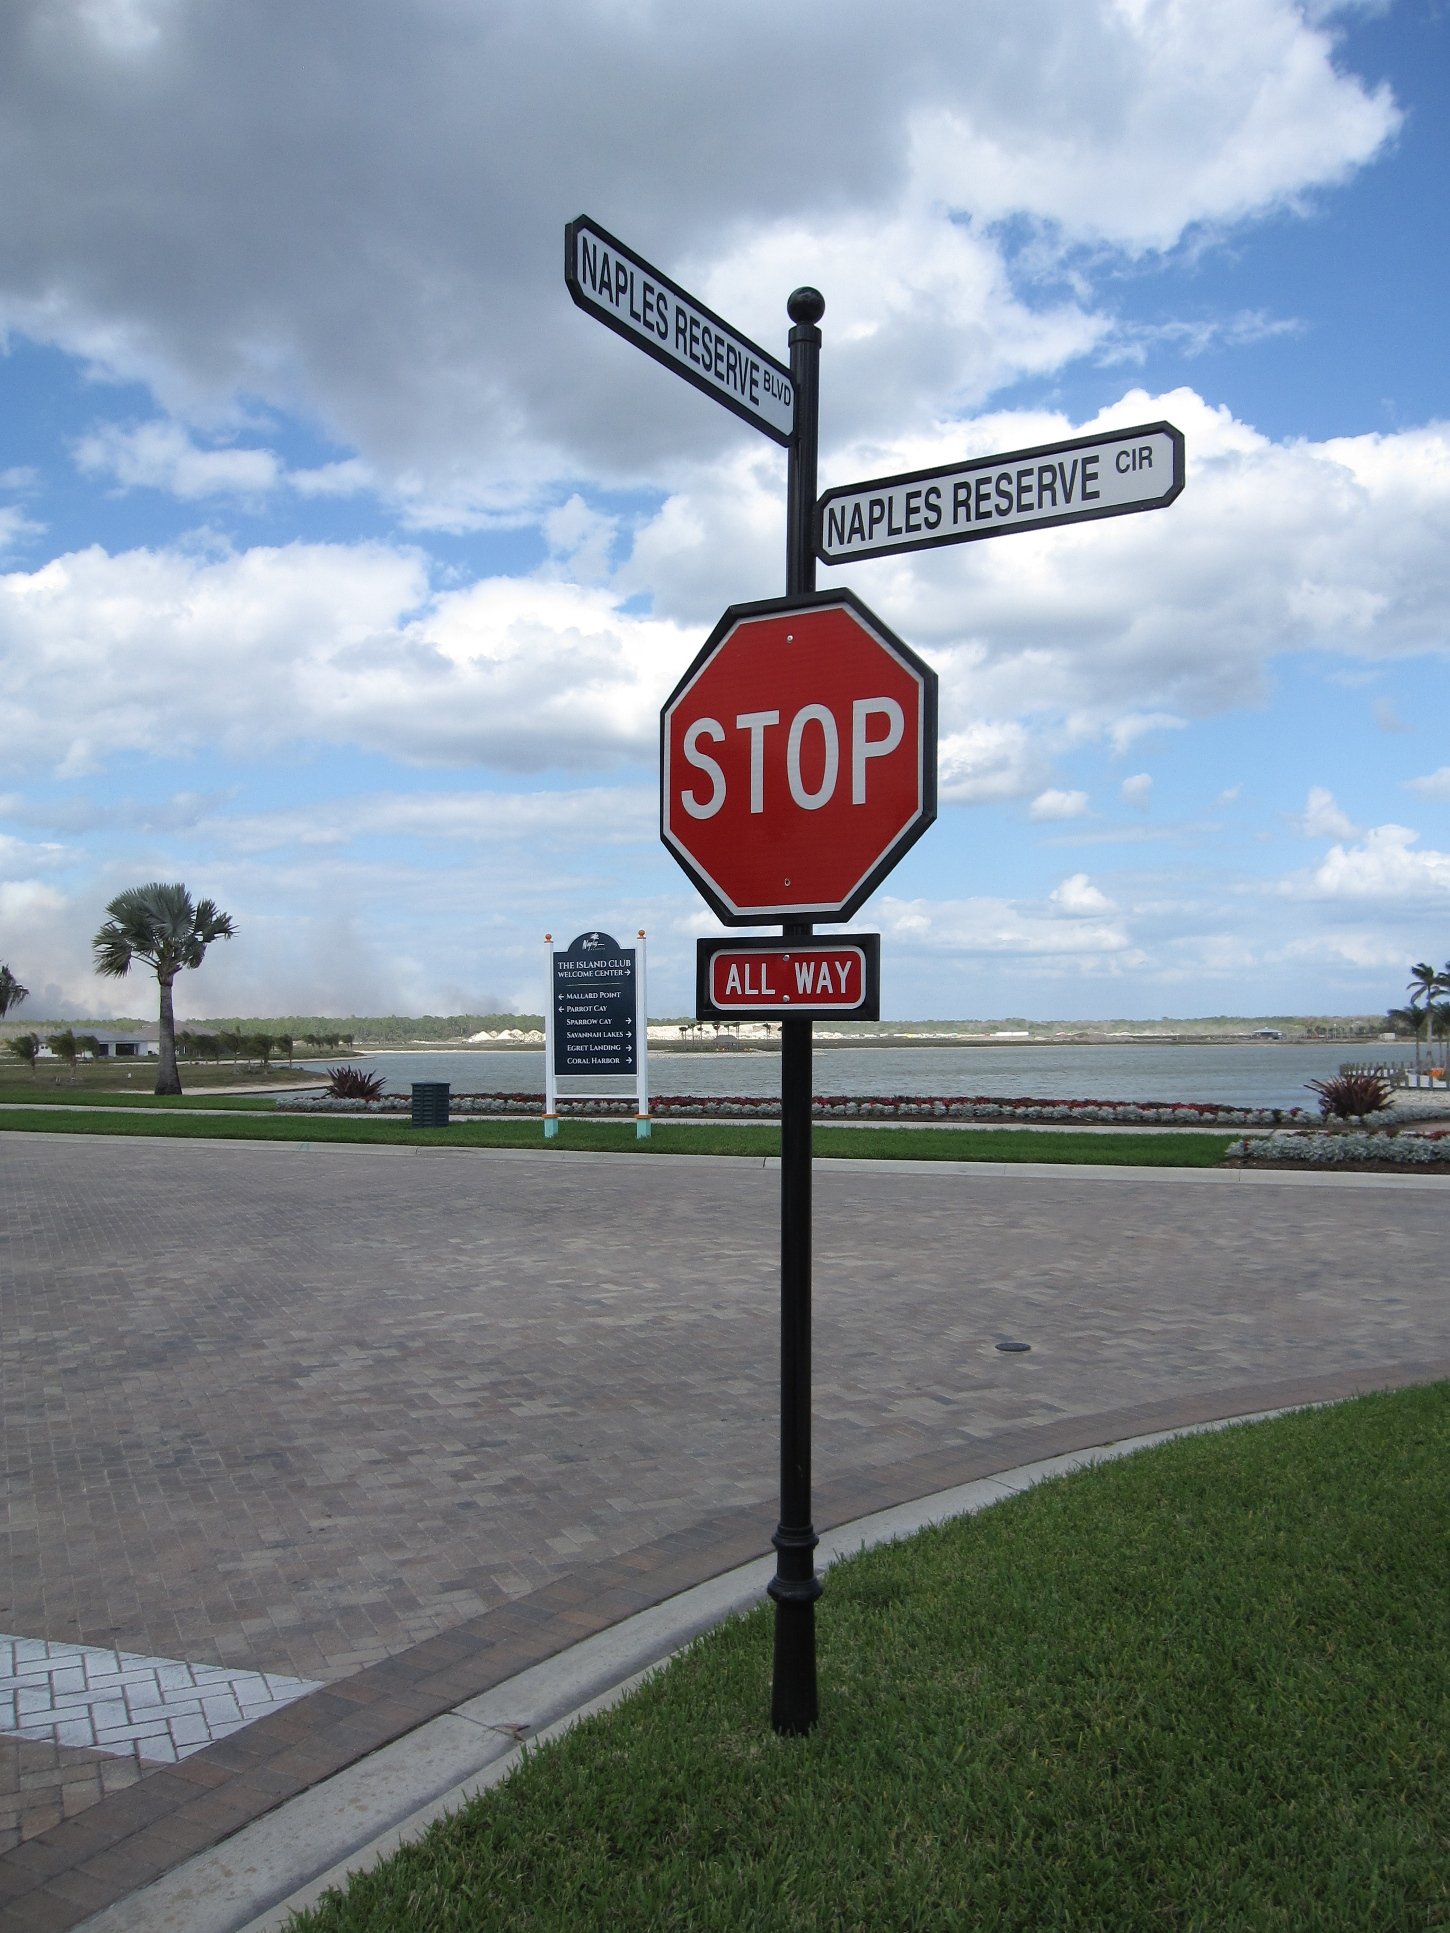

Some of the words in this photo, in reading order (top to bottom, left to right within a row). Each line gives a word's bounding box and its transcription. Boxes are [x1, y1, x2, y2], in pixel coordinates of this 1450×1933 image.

[583, 236, 668, 340] NAPLES
[675, 305, 759, 406] RESERVE
[764, 369, 791, 406] BLVD
[828, 487, 941, 547] NAPLES
[953, 455, 1100, 524] RESERVE
[1116, 446, 1153, 473] CIR
[681, 697, 904, 819] STOP
[557, 961, 575, 970] THE
[576, 959, 607, 969] ISLAND
[608, 959, 631, 968] CLUB
[557, 970, 593, 978] WELCOME
[594, 969, 624, 977] CENTER
[725, 963, 776, 994] ALL
[795, 961, 852, 994] WAY
[566, 992, 598, 1000] MALLARD
[599, 991, 621, 999] POINT
[566, 1005, 593, 1013] PARROT
[566, 1018, 597, 1026] SPARROW
[566, 1031, 602, 1039] SAVANNAH
[566, 1057, 590, 1065] CORAL
